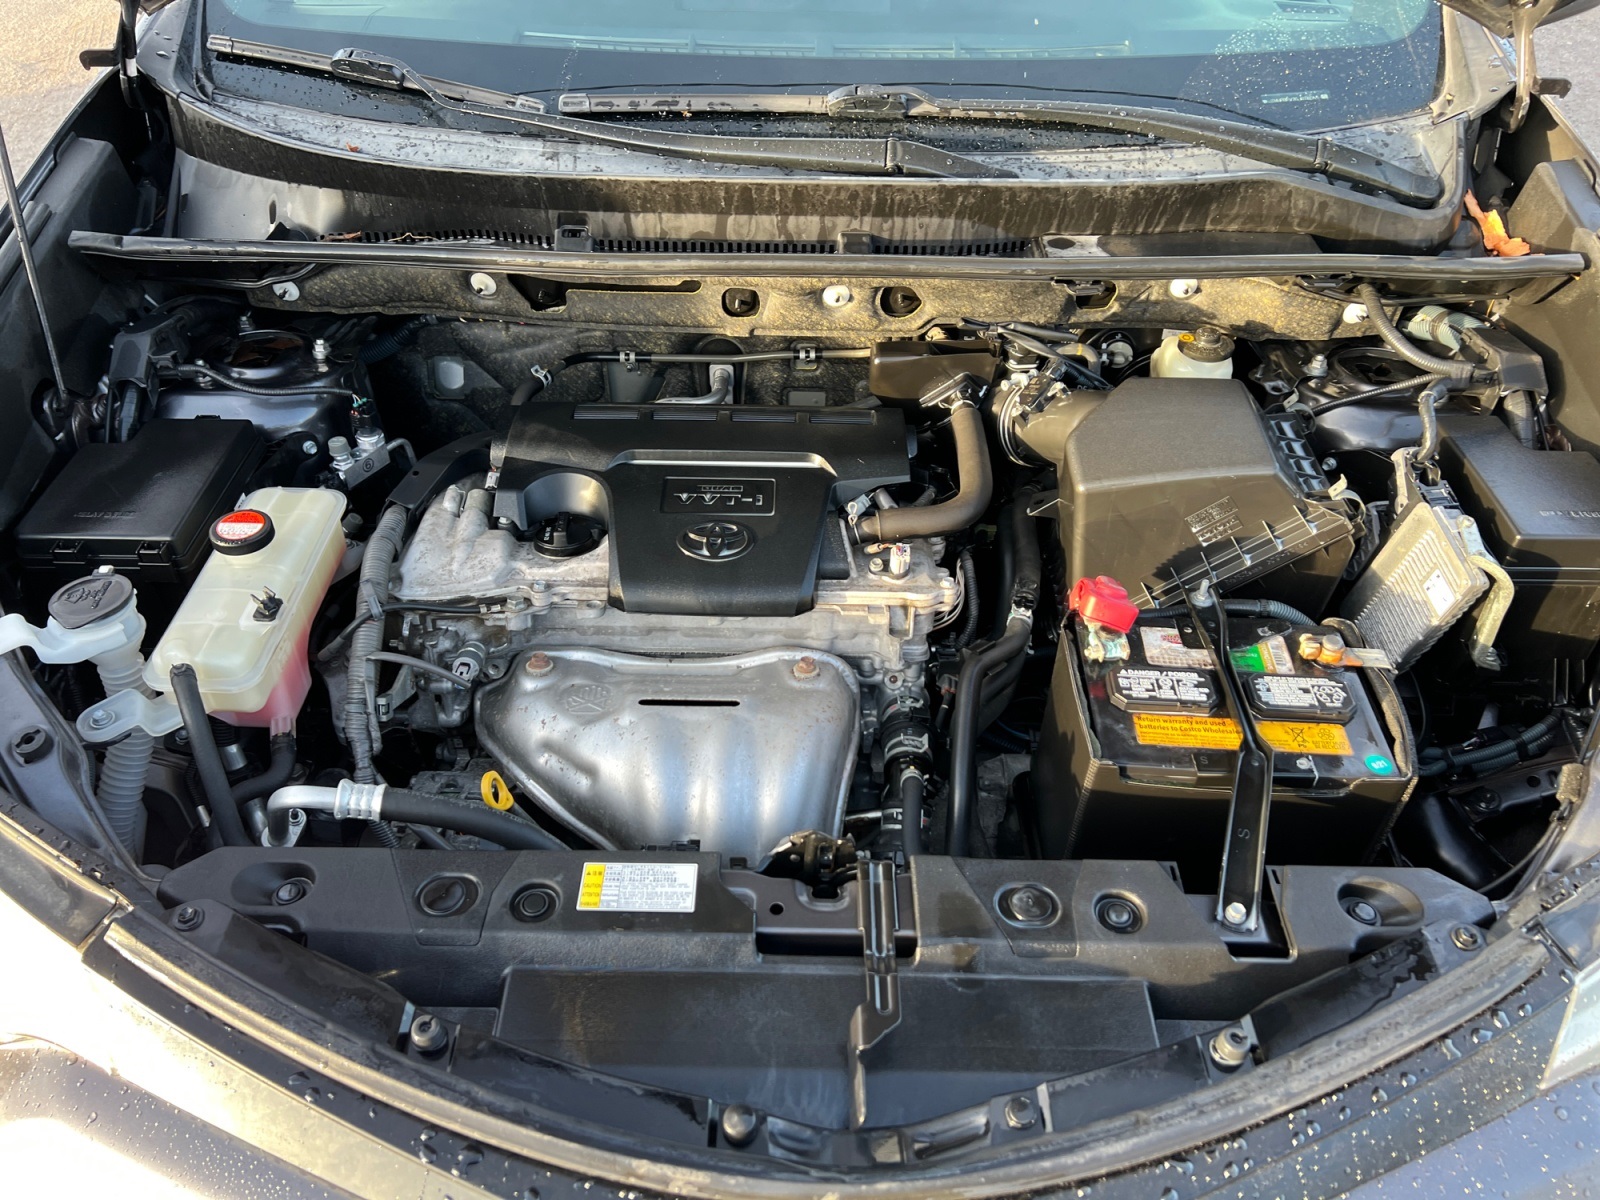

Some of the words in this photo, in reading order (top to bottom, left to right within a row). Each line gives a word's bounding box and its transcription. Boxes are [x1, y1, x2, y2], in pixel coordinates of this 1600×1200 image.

[1127, 669, 1161, 677] DANGER
[1162, 718, 1193, 726] warranty
[1139, 722, 1170, 731] batteries
[1179, 725, 1202, 733] Costco
